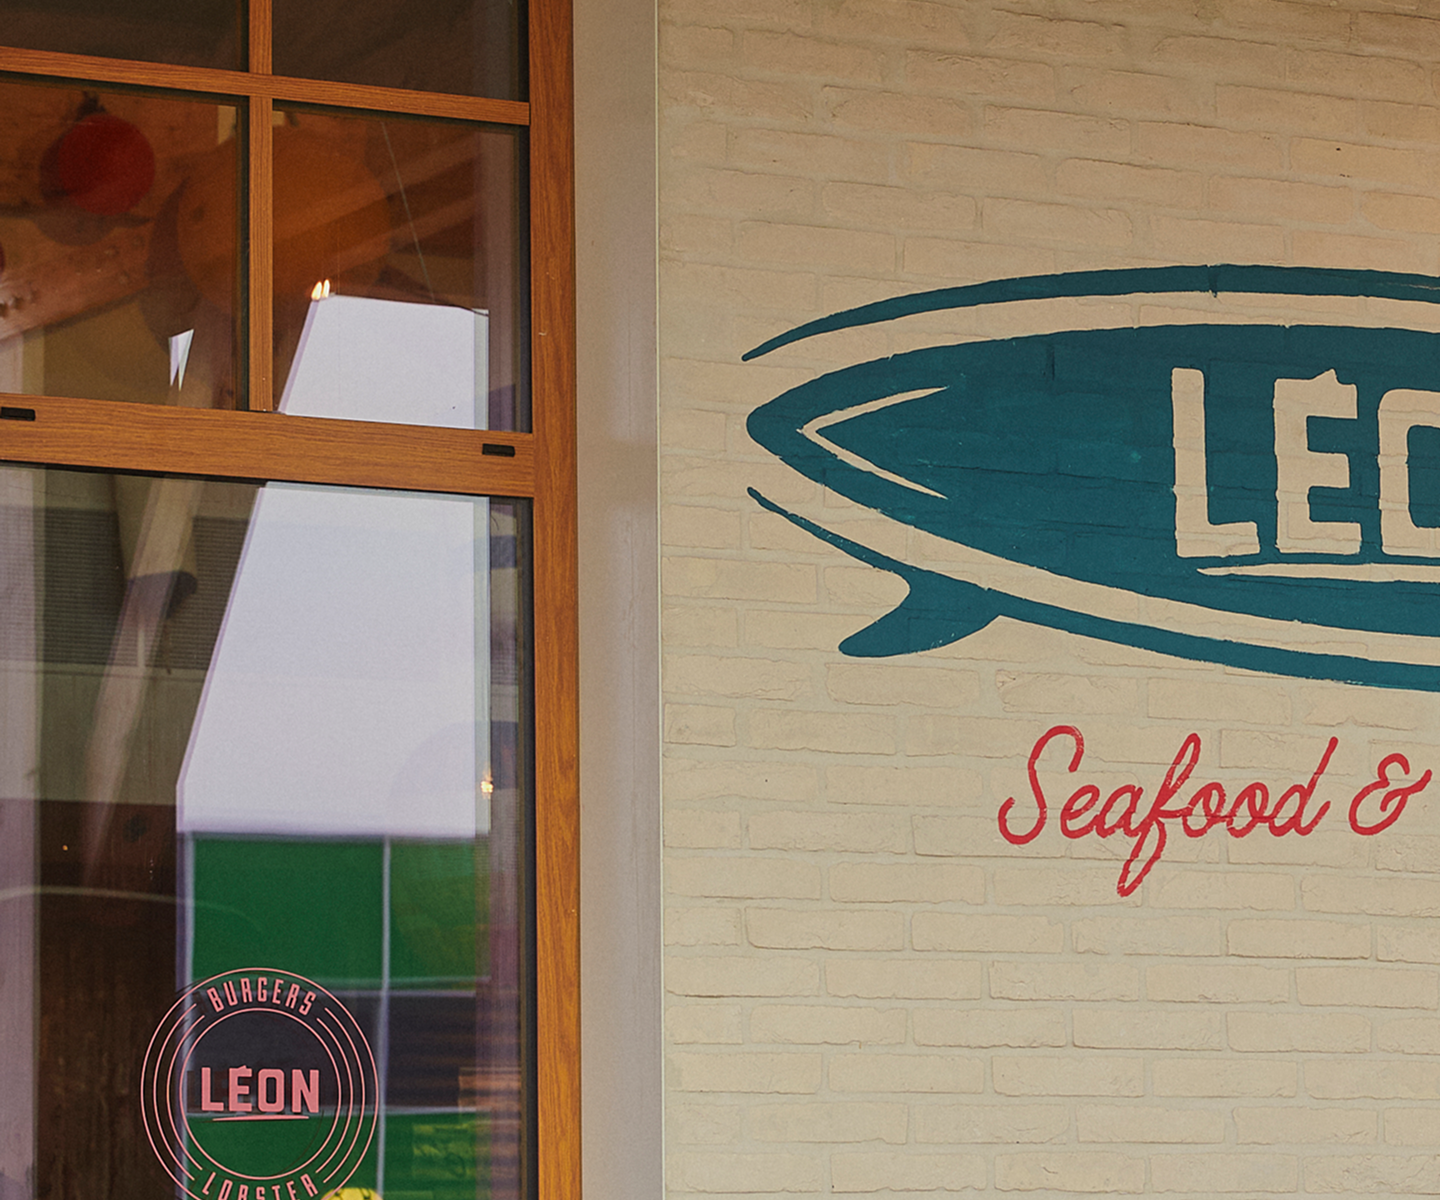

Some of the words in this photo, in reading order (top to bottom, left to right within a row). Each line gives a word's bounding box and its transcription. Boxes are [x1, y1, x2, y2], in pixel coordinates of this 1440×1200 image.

[997, 725, 1338, 897] Seafood
[1348, 753, 1432, 836] &
[207, 976, 317, 1016] BURGERS
[201, 1065, 320, 1114] LÉON
